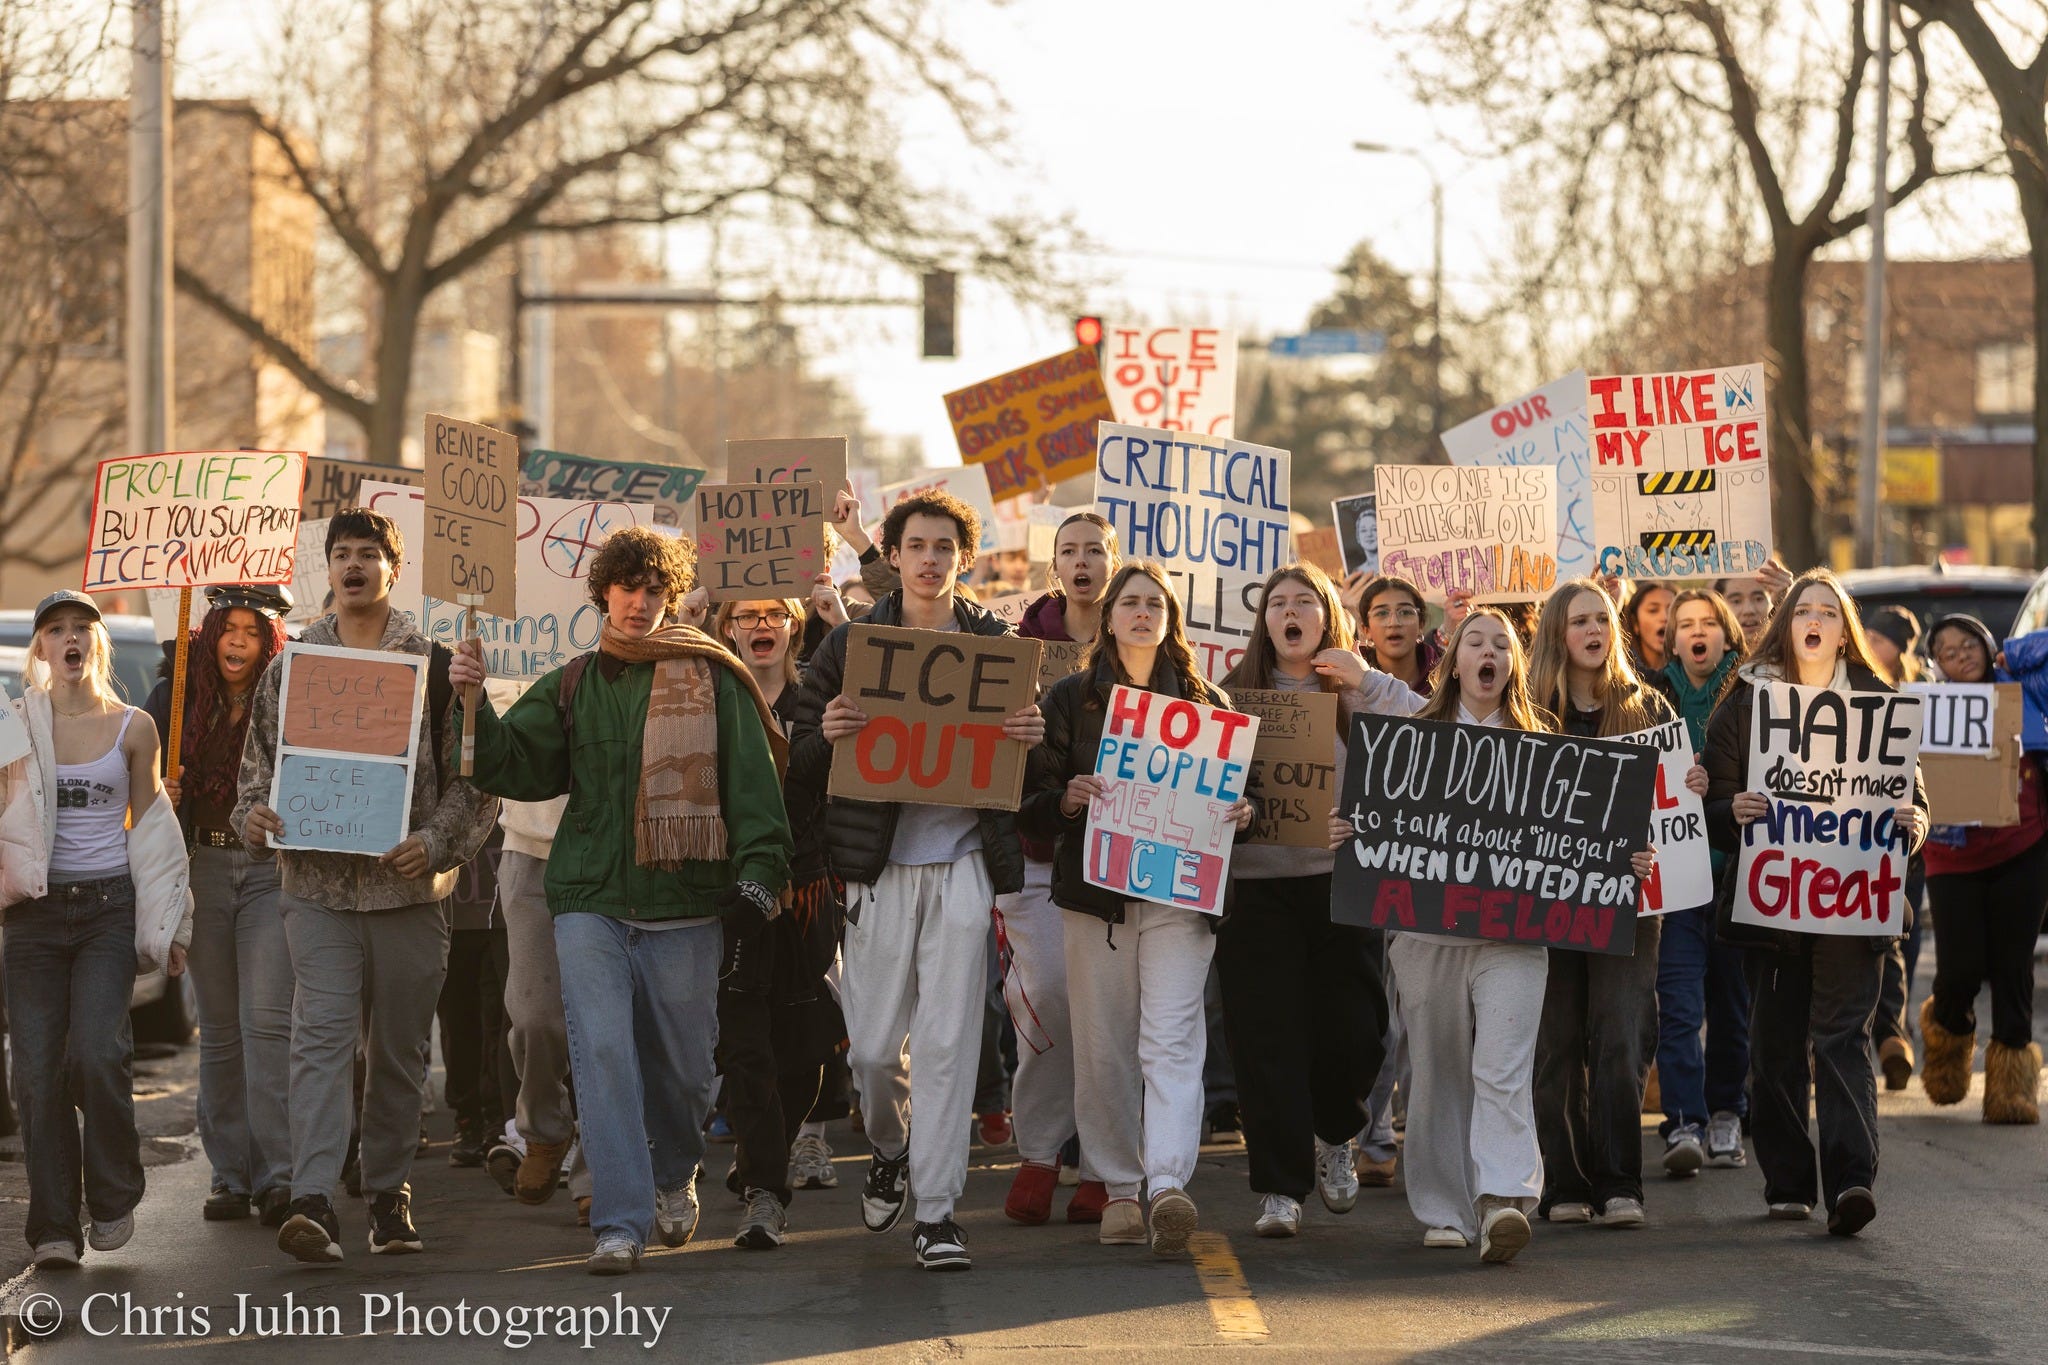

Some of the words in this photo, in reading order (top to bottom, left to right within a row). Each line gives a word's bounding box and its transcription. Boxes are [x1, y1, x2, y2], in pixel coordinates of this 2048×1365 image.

[1115, 328, 1218, 361] ICE
[1115, 363, 1217, 388] OUT
[1133, 387, 1200, 416] OF
[1491, 394, 1553, 439] OUR
[1590, 377, 1628, 429] I
[1632, 373, 1717, 427] LIKE
[435, 422, 498, 469] RENEE
[1595, 429, 1651, 468] MY
[1703, 422, 1762, 466] ICE
[442, 462, 507, 514] GOOD
[548, 459, 668, 500] ICE
[1098, 436, 1288, 513] CRITICAL
[1377, 466, 1426, 506] NO
[1431, 468, 1492, 505] ONE
[1499, 467, 1547, 502] IS
[102, 506, 161, 547] BUT
[167, 504, 206, 539] YOU
[210, 505, 300, 539] SUPPORT
[700, 489, 765, 522] HOT
[771, 488, 822, 518] PPL
[1378, 501, 1494, 546] ILLEGAL
[1498, 503, 1547, 544] ON
[434, 514, 473, 547] ICE
[726, 524, 797, 554] MELT
[1097, 496, 1289, 575] THOUGHT
[190, 536, 246, 581] WHO
[239, 544, 295, 582] KILLS
[451, 553, 495, 594] BAD
[715, 557, 796, 590] ICE
[1382, 544, 1495, 597] STOLEN
[1494, 543, 1557, 594] LAND
[1600, 539, 1766, 578] CRUSHED
[860, 637, 1016, 713] ICE
[1234, 691, 1299, 705] DESERVE
[1290, 709, 1310, 722] AT
[1109, 687, 1250, 760] HOT
[1759, 687, 1921, 765] HATE
[1919, 694, 1990, 748] UR
[855, 715, 1009, 790] OUT
[1095, 738, 1243, 801] PEOPLE
[304, 765, 365, 786] ICE
[1273, 762, 1336, 790] OUT
[1360, 721, 1437, 801] YOU
[1541, 743, 1638, 832] GET
[1765, 755, 1847, 797] doesn't
[1851, 773, 1908, 799] make
[288, 793, 371, 813] OUT!!
[1090, 775, 1233, 849] MELT
[299, 818, 365, 839] GTFO!!!
[1350, 803, 1381, 833] to
[1392, 808, 1451, 845] talk
[1456, 819, 1523, 852] about
[1661, 812, 1703, 845] FOR
[1098, 831, 1202, 901] ICE
[1354, 838, 1449, 882] WHEN
[1455, 850, 1479, 883] U
[1489, 853, 1580, 901] VOTED
[1582, 871, 1635, 905] FOR
[1748, 849, 1901, 924] Great
[1371, 878, 1417, 928] A
[1442, 883, 1616, 950] FELON
